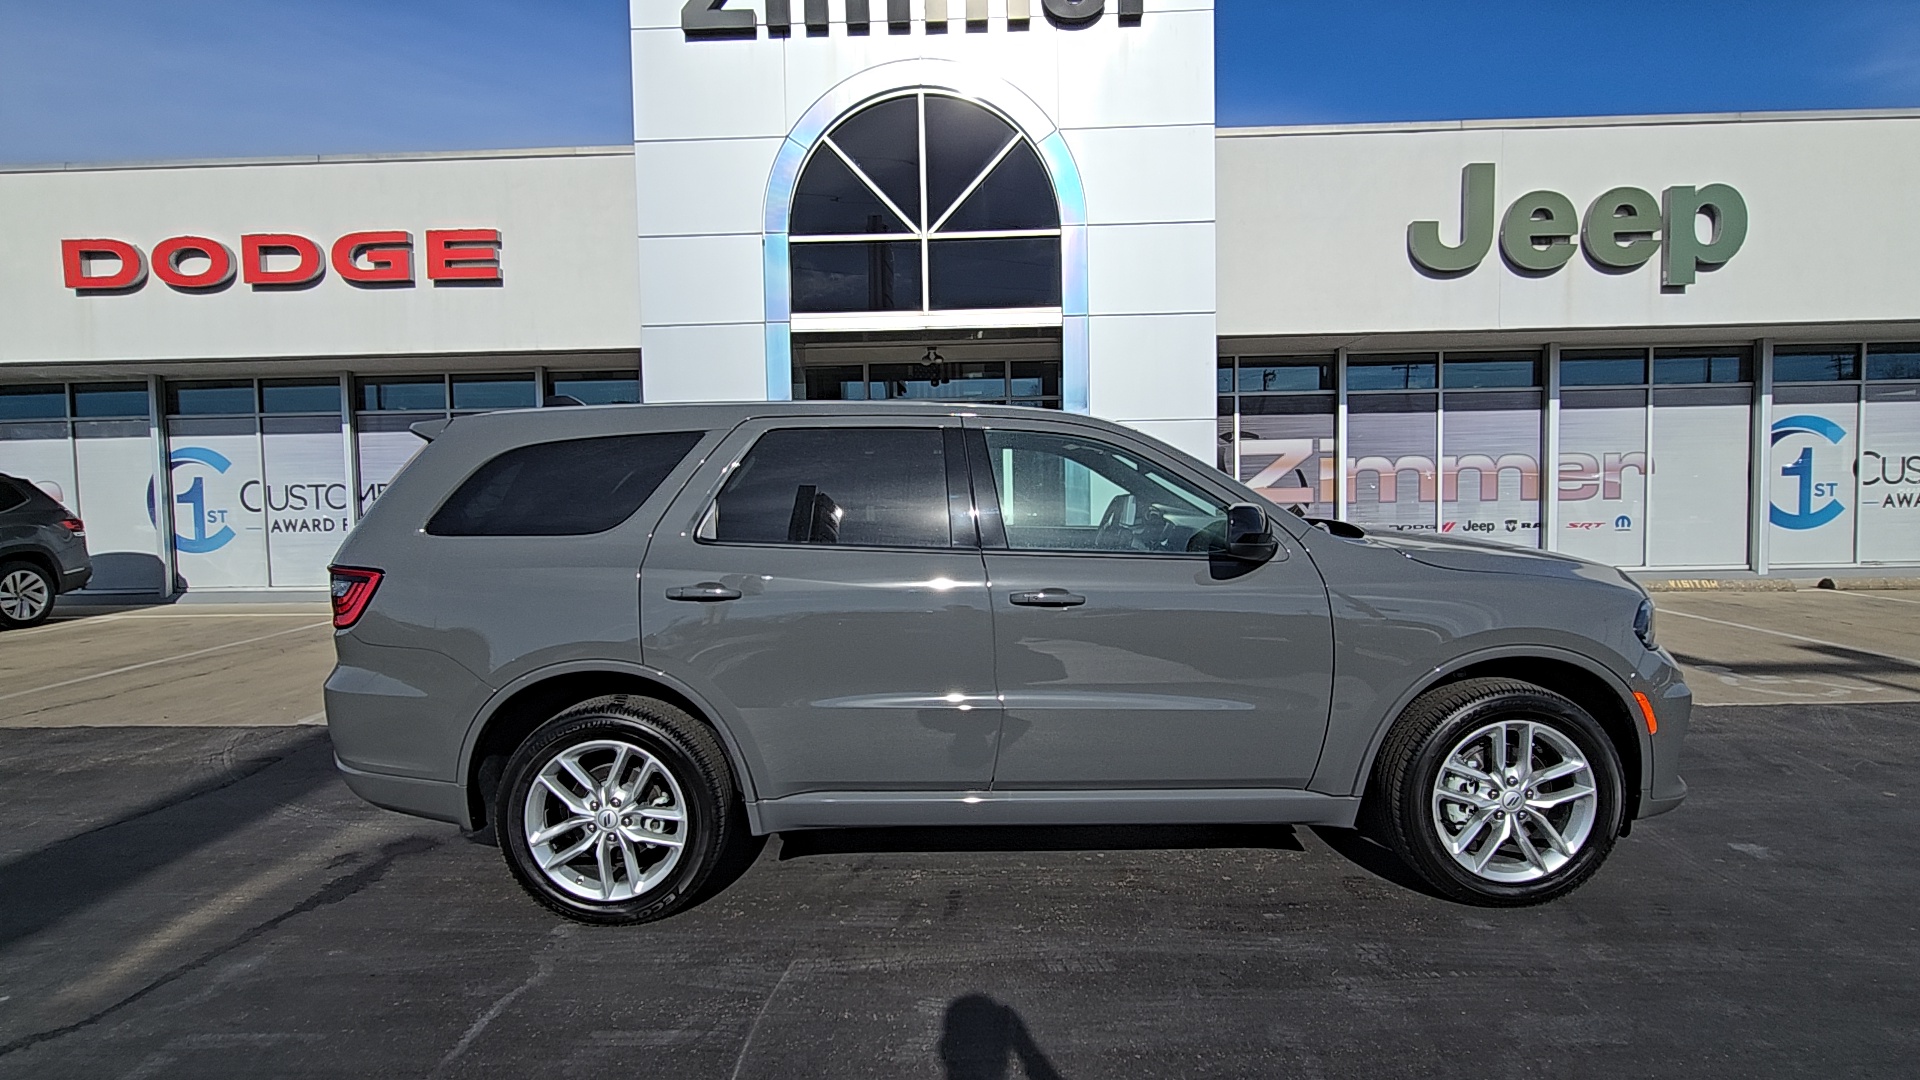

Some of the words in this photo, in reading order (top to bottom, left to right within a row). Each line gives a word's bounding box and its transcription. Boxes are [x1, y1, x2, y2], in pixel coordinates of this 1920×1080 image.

[1407, 162, 1748, 291] Jeep
[61, 229, 502, 294] DODGE
[1240, 438, 1655, 504] Zimmer
[271, 518, 336, 533] AWARD
[1463, 520, 1495, 533] Jeep
[1566, 522, 1606, 530] SRT
